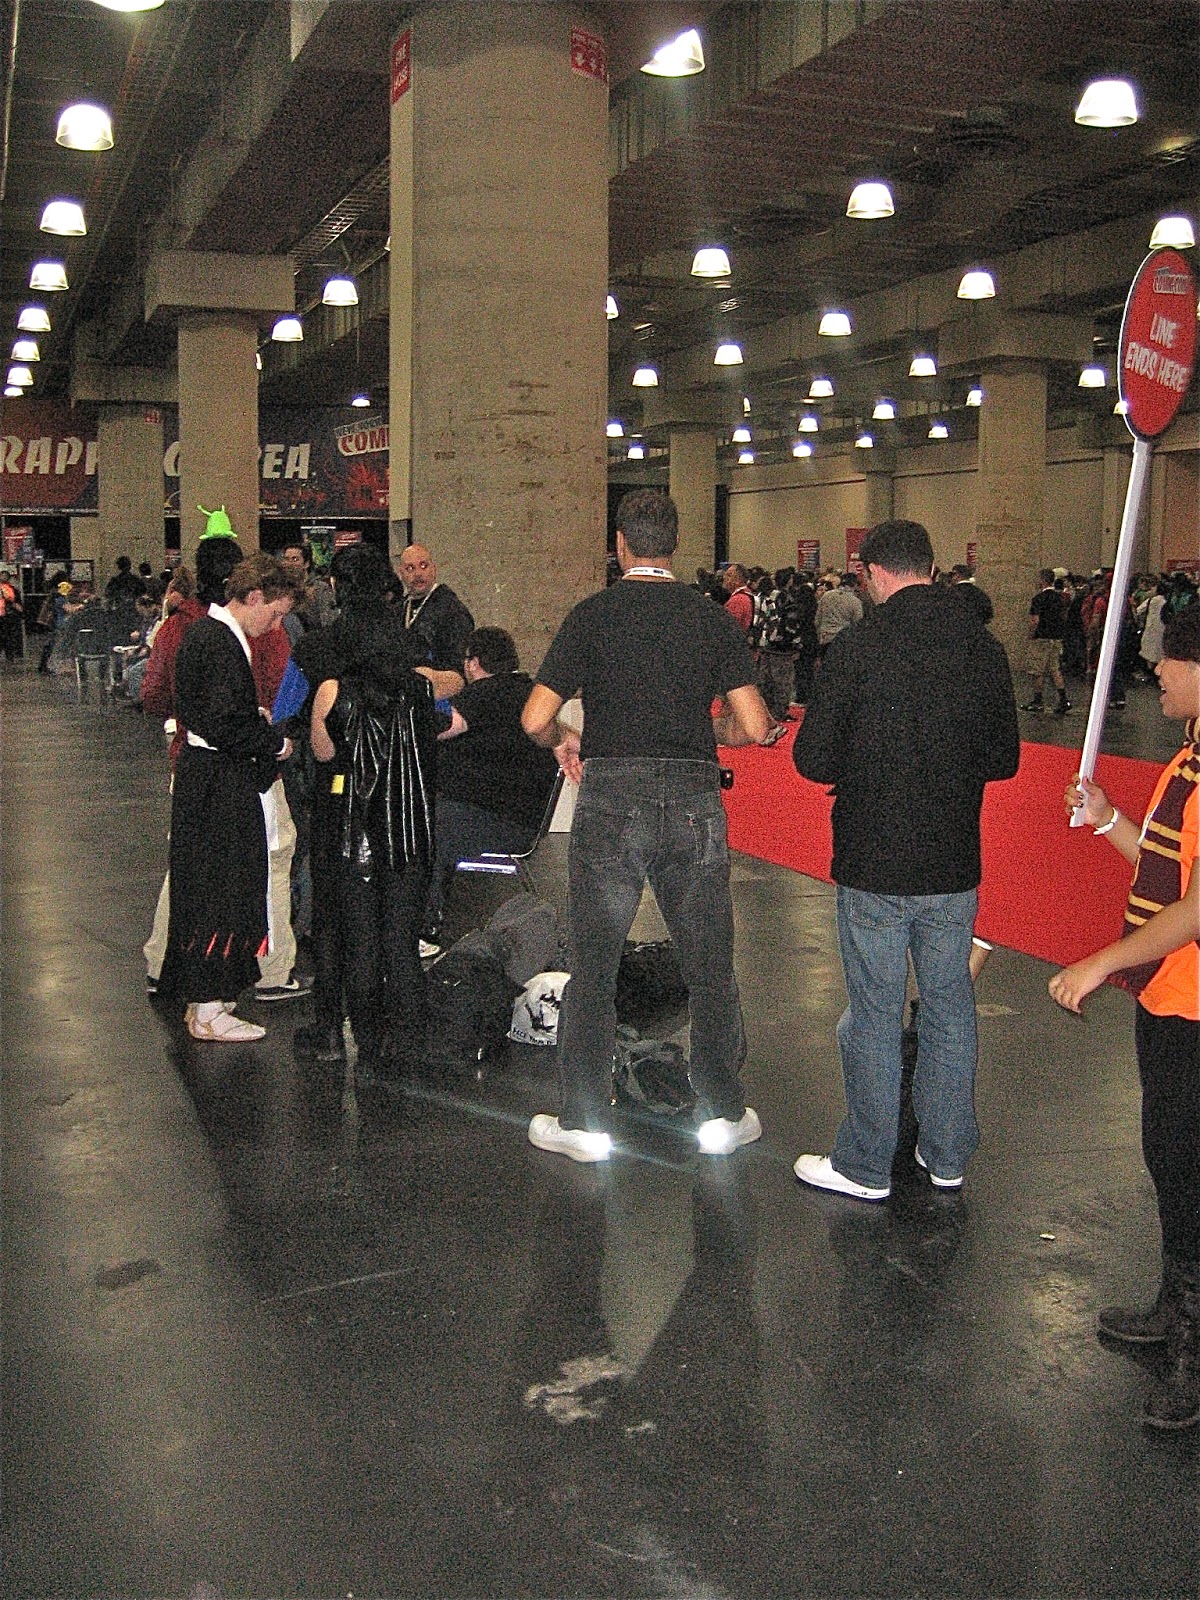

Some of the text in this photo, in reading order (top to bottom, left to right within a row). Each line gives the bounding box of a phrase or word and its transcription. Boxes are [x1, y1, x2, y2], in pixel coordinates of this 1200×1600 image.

[1150, 313, 1177, 348] LINE
[1125, 342, 1189, 392] ENDS HERE
[258, 443, 310, 479] EA
